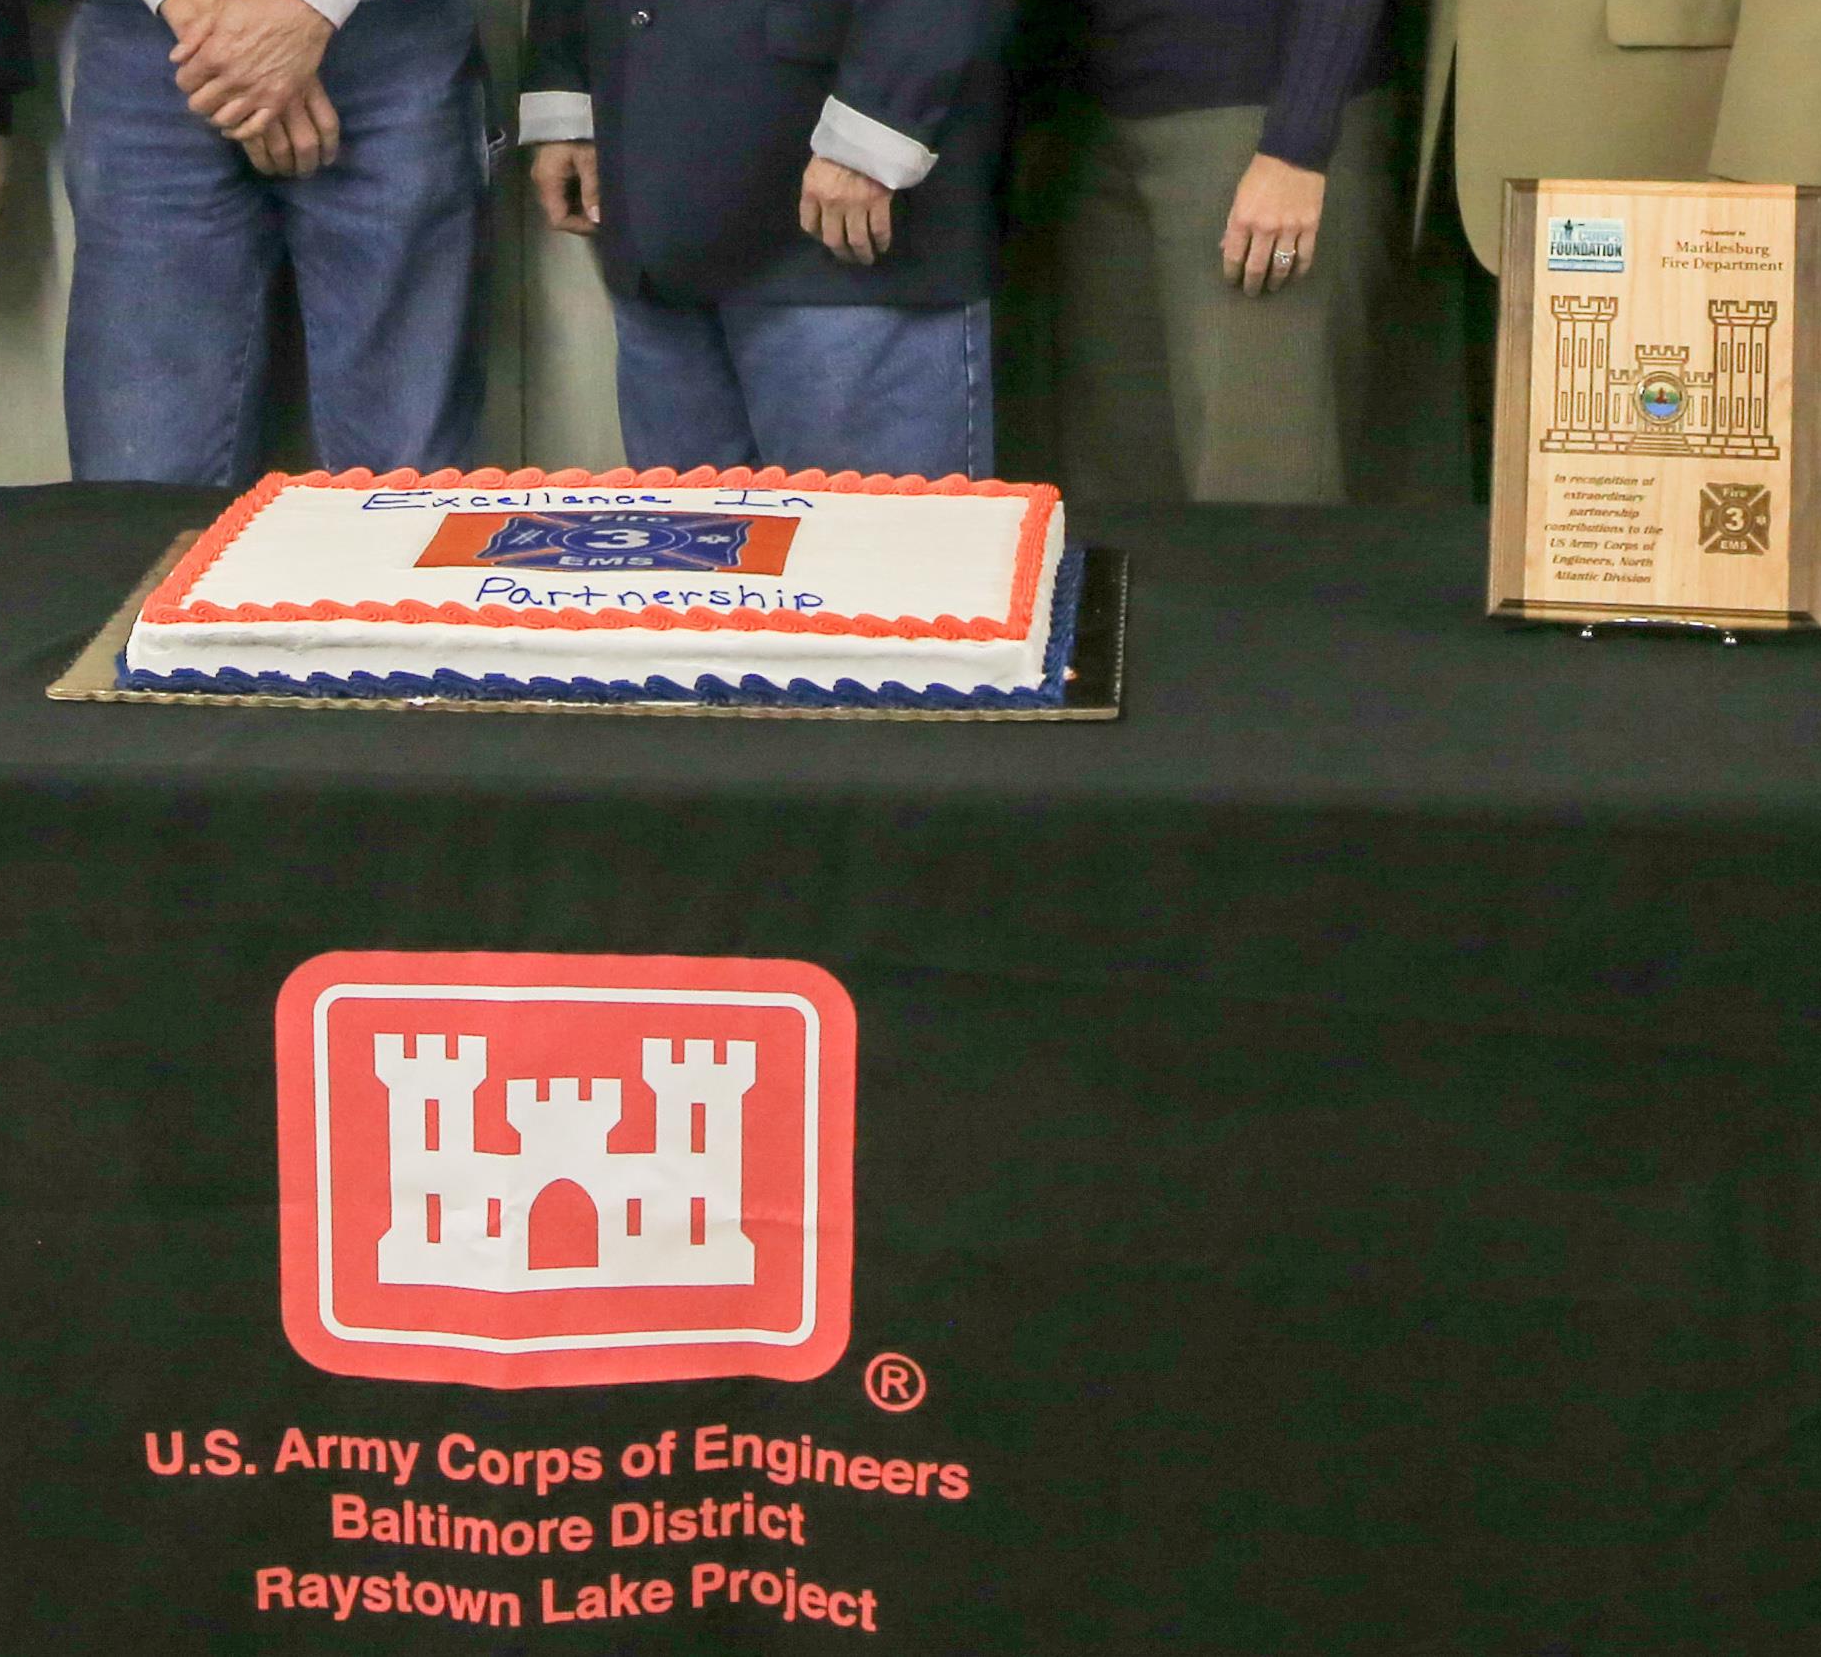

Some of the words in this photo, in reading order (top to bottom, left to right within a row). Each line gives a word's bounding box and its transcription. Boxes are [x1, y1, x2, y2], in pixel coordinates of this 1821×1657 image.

[1551, 241, 1623, 257] FOUNDATION
[1675, 240, 1771, 258] Marklesburg
[1661, 256, 1689, 269] Fire
[1694, 257, 1784, 273] Department
[1553, 474, 1567, 483] In
[1569, 476, 1639, 486] recognition
[1641, 477, 1656, 486] of
[714, 489, 814, 508] In
[1563, 491, 1645, 502] extraordinary
[1723, 487, 1747, 498] Fire
[589, 514, 671, 524] Fire
[1568, 508, 1640, 520] partnership
[1724, 507, 1745, 531] 3
[1544, 522, 1624, 533] contributions
[1628, 525, 1640, 534] to
[1643, 525, 1664, 535] the
[586, 529, 651, 554] 3
[1569, 539, 1599, 550] Army
[1603, 540, 1639, 552] Corps
[1642, 541, 1656, 551] of
[1720, 540, 1748, 551] EMS
[558, 556, 654, 567] EMS
[1552, 554, 1616, 566] Engineers,
[1619, 556, 1654, 567] North
[1554, 570, 1599, 581] Atlantic
[1602, 572, 1652, 583] Division
[475, 577, 825, 610] Partnership
[145, 1430, 258, 1476] U.S.
[275, 1428, 420, 1485] Army
[438, 1434, 604, 1496] Corps
[621, 1431, 678, 1478] of
[695, 1425, 970, 1500] Engineers
[332, 1494, 594, 1556] Baltimore
[611, 1493, 806, 1547] District
[257, 1567, 521, 1627] Raystown
[541, 1574, 675, 1623] Lake
[691, 1563, 877, 1632] Project
